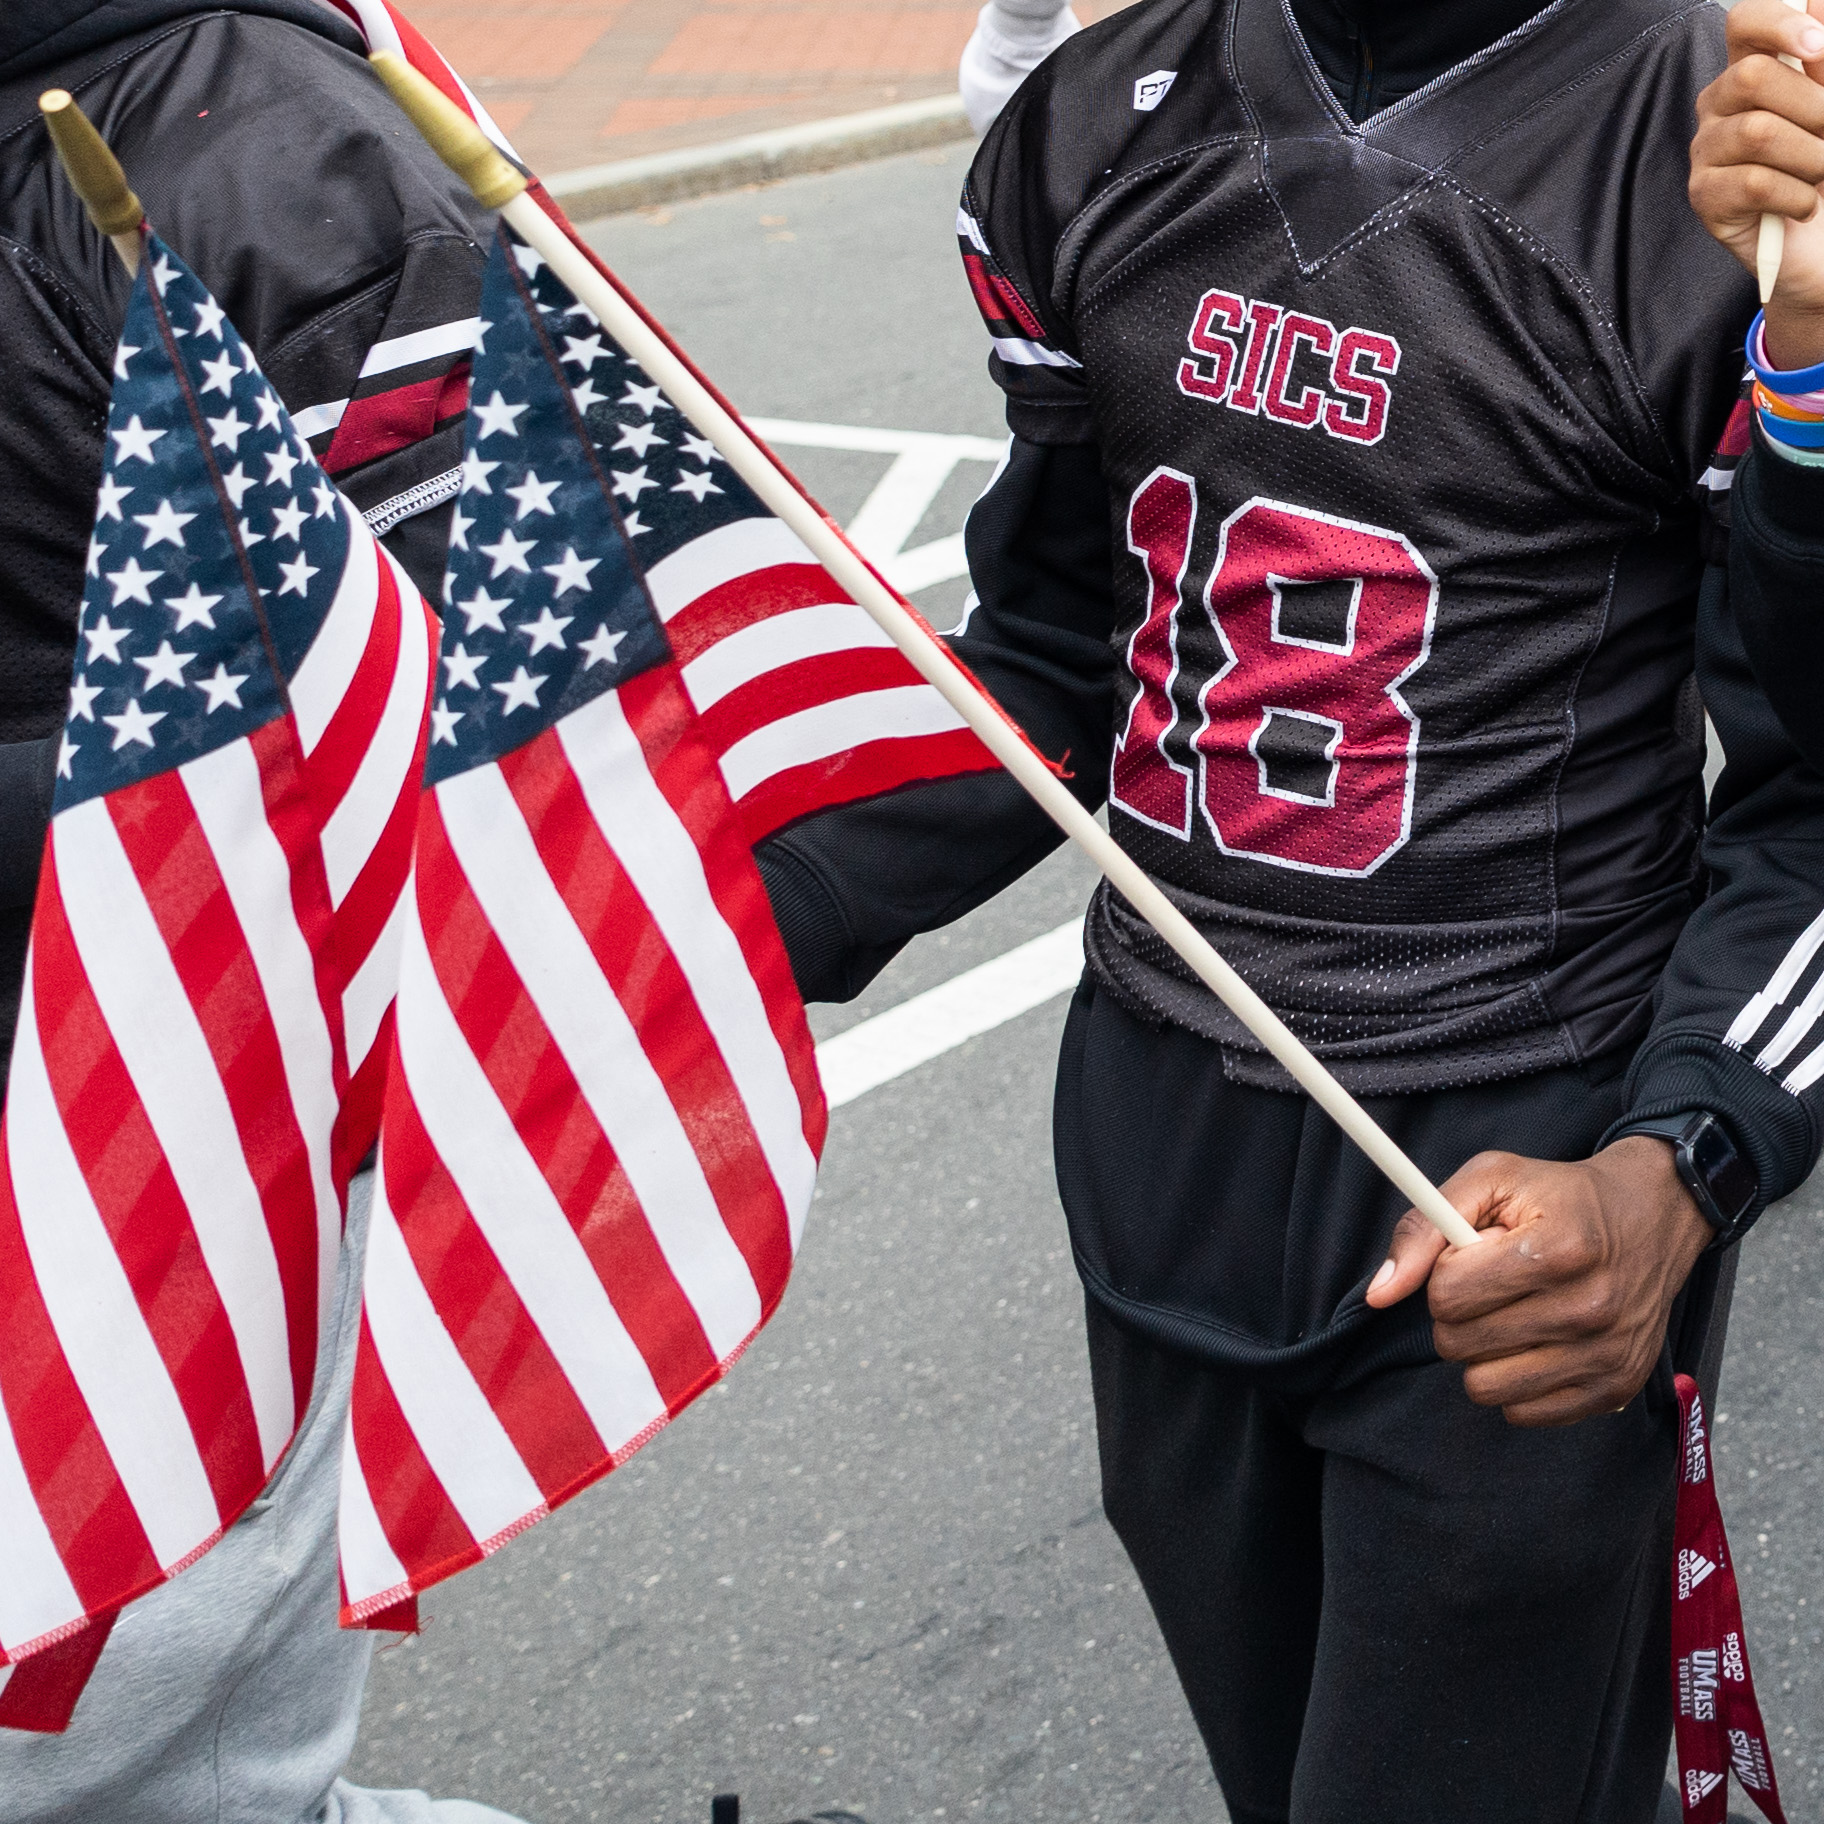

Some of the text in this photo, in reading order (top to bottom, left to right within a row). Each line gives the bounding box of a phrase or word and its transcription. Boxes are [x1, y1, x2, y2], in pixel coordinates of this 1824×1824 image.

[1176, 288, 1401, 446] SICS
[1109, 465, 1441, 878] 18
[1678, 1548, 1691, 1601] adidas
[1678, 1657, 1691, 1716] FOOTBALL
[1726, 1632, 1745, 1682] adidas
